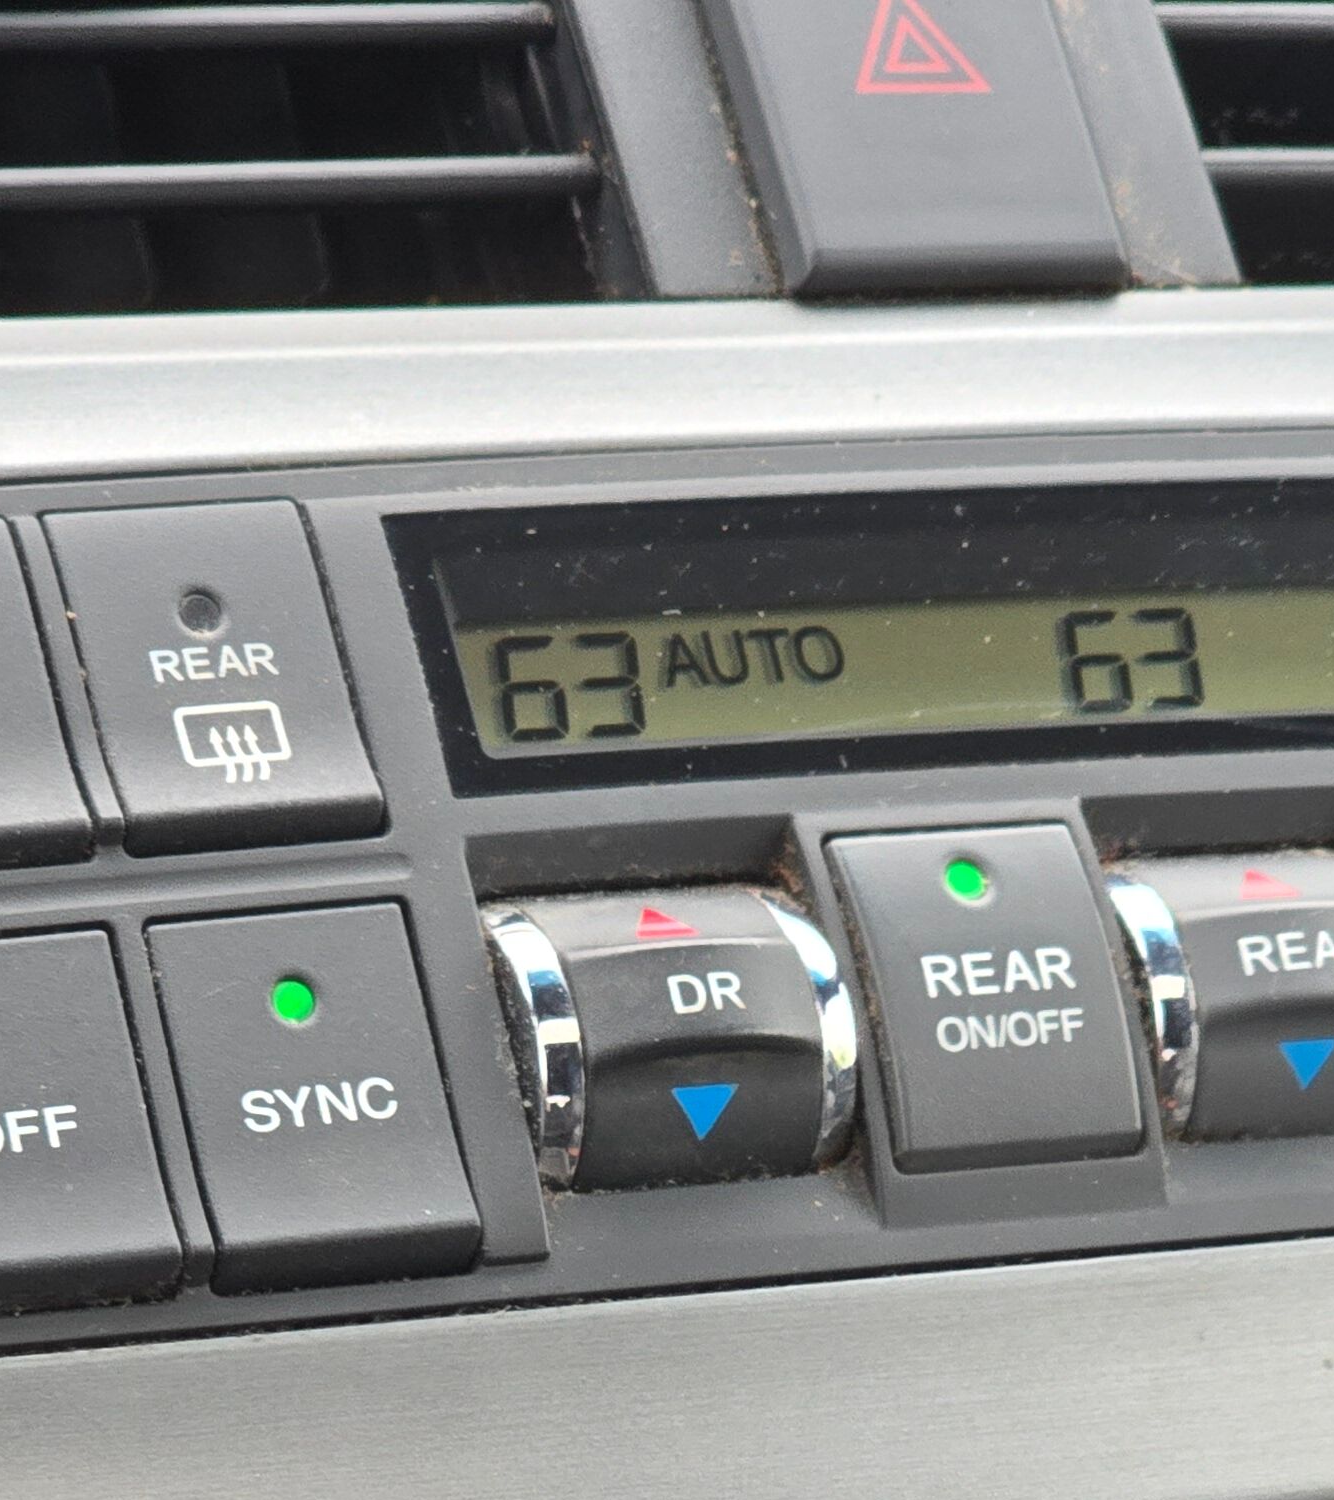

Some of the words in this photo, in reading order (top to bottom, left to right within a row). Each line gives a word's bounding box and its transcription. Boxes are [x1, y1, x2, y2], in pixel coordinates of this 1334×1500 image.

[147, 642, 281, 684] REAR
[487, 630, 650, 744] 63
[662, 620, 849, 694] AUTO
[1062, 603, 1209, 718] 63
[666, 970, 747, 1015] DR
[919, 946, 1077, 999] REAR
[935, 1006, 1085, 1054] ON/OFF
[240, 1076, 399, 1134] SYNC
